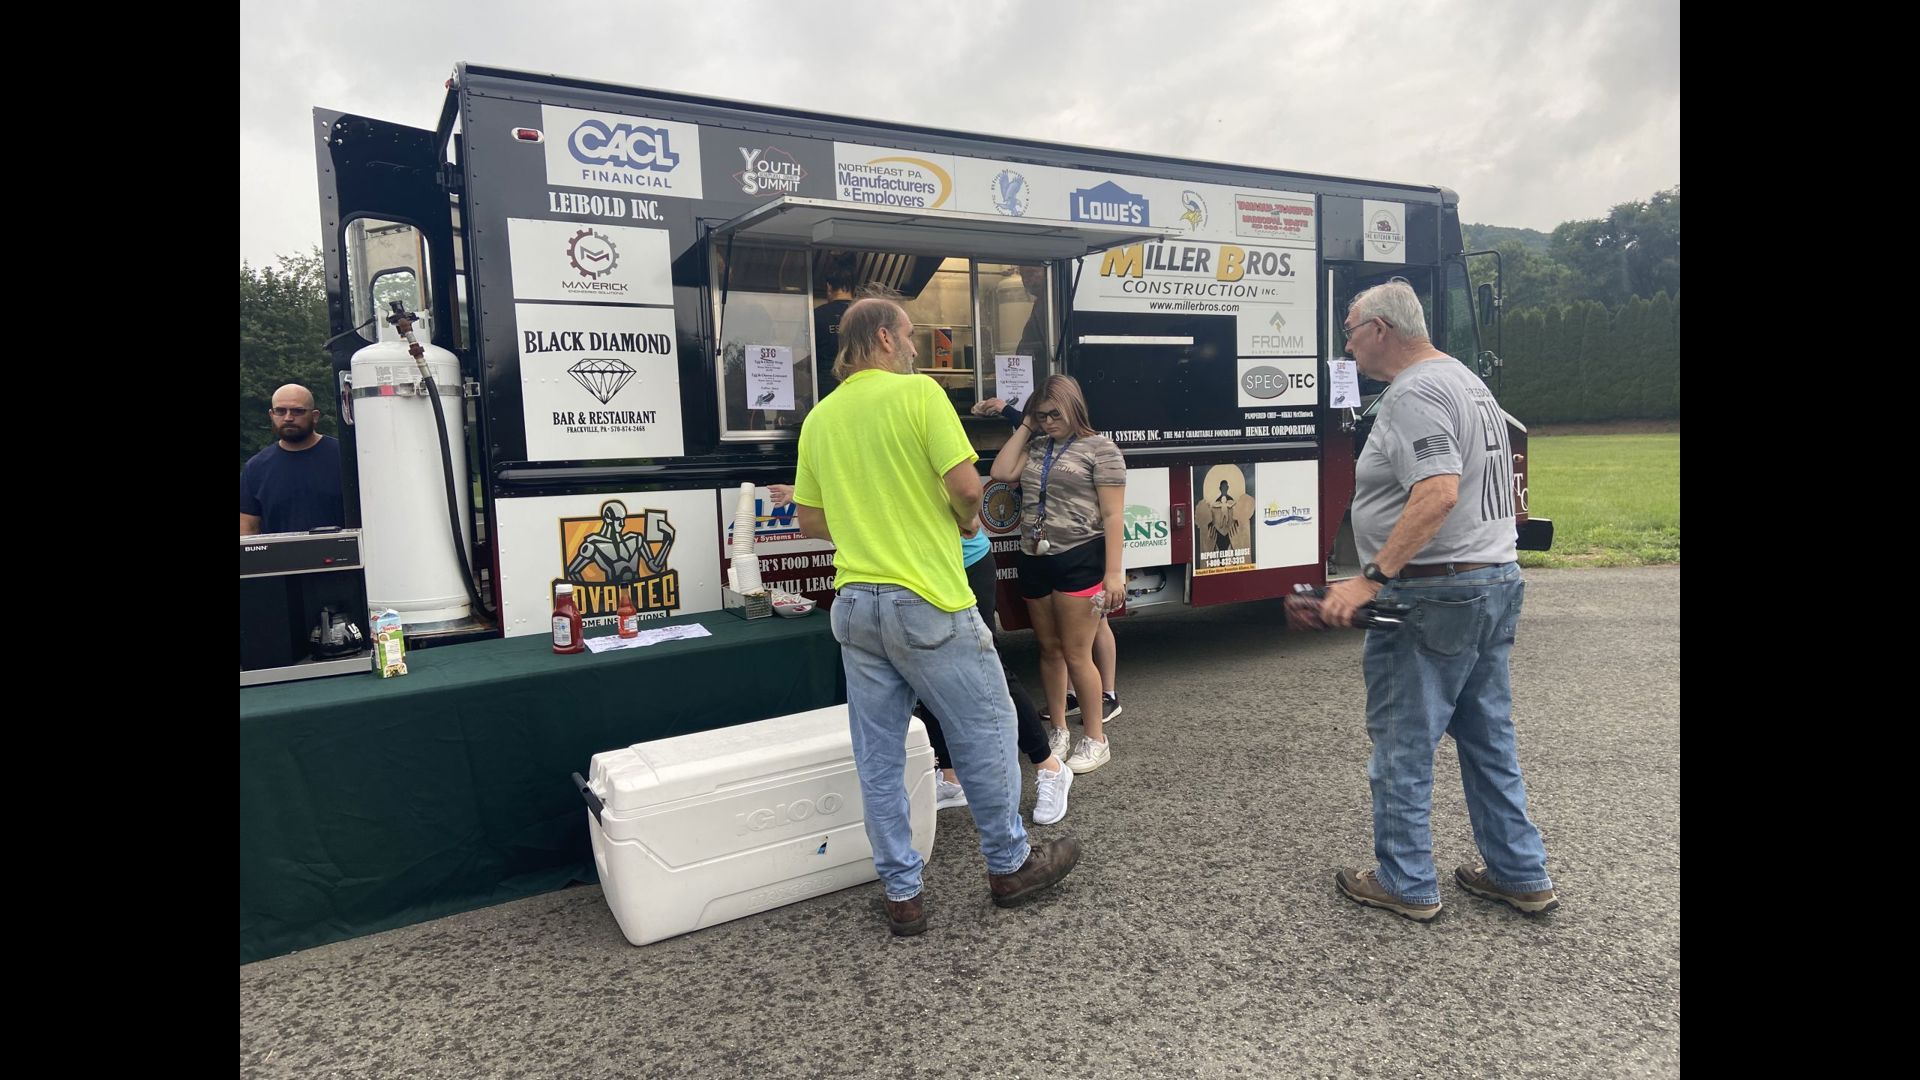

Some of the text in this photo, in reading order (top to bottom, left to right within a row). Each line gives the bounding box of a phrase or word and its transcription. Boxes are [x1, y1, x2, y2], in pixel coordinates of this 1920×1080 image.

[570, 121, 679, 172] CACL
[739, 147, 801, 176] YOUTH
[582, 169, 672, 189] FINANCIAL
[838, 163, 922, 179] NORTHEAST PA
[742, 171, 801, 194] SUMMIT
[839, 172, 935, 194] Manufacturers
[549, 191, 664, 221] LEIBOLD INC.
[844, 188, 925, 207] & Employers
[1079, 196, 1143, 224] LOWE'S
[1100, 244, 1295, 282] MILLER BROS.
[562, 281, 628, 291] MAVERICK
[1122, 280, 1279, 298] CONSTRUCTION INC.
[1149, 301, 1240, 313] www.millerbros.com
[524, 331, 671, 355] BLACK DIAMOND
[1251, 335, 1303, 349] FROMM
[552, 410, 657, 426] BAR & RESTAURANT
[1115, 430, 1146, 442] SYSTEMS
[1147, 430, 1161, 441] INC.
[1163, 431, 1173, 440] THE
[1214, 429, 1242, 438] FOUNDATION
[1245, 424, 1316, 437] HENKEL CORPORATION
[1264, 507, 1290, 518] HIDDEN
[760, 534, 791, 543] Systems
[1130, 539, 1168, 548] COMPANIES
[781, 555, 809, 571] FOOD
[812, 553, 835, 567] MAR
[1201, 550, 1219, 560] REPORT
[1220, 549, 1234, 559] ELDER
[806, 575, 836, 591] LEAG
[573, 573, 676, 616] DVATEC
[582, 618, 602, 628] OME
[736, 792, 843, 837] IGLOO
